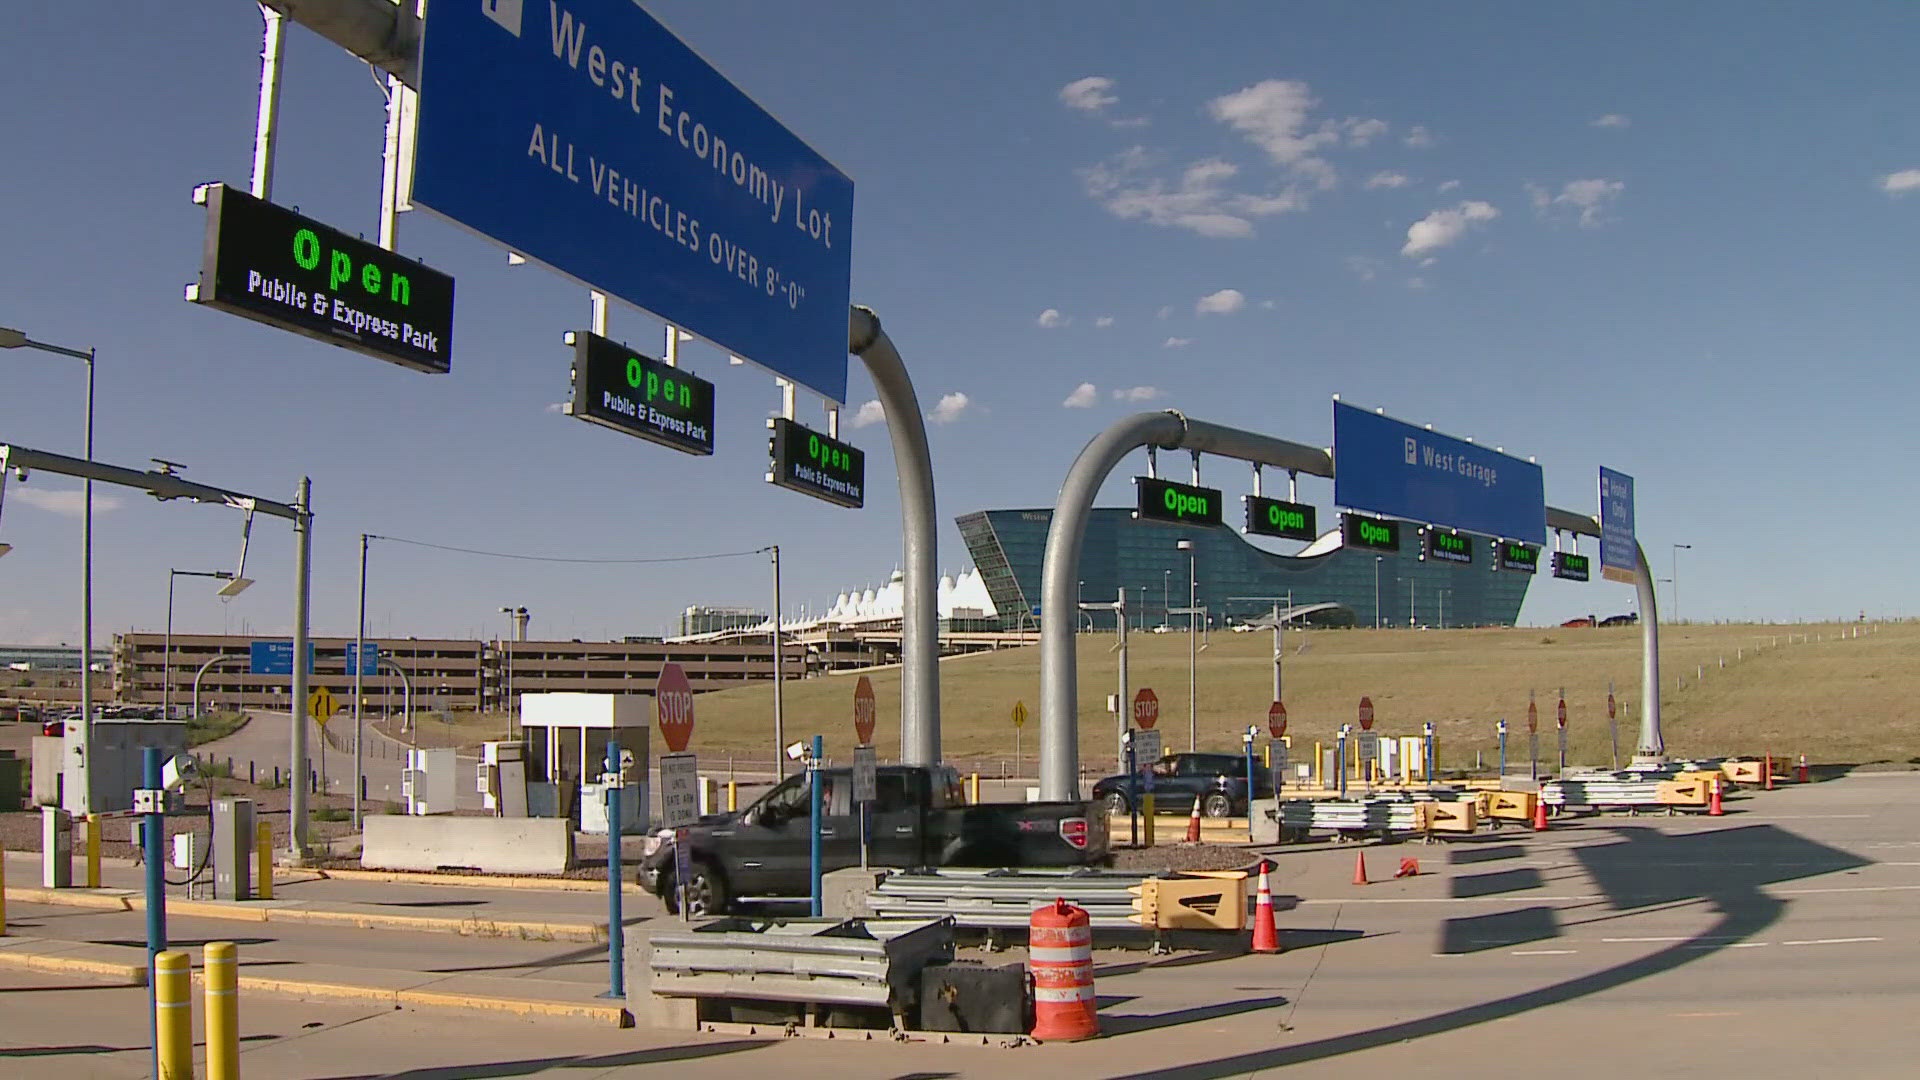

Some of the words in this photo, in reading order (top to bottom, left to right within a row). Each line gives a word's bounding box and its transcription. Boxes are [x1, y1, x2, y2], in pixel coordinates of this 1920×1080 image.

[550, 0, 641, 114] West
[658, 83, 784, 223] Economy
[796, 188, 832, 249] Lot
[528, 123, 579, 183] ALL
[590, 156, 699, 252] VEHICLES
[709, 232, 758, 288] OVER
[293, 228, 411, 306] Open
[248, 269, 307, 310] Public
[312, 292, 329, 316] &
[332, 298, 399, 340] Express
[403, 322, 438, 352] Park
[626, 358, 691, 409] Open
[603, 390, 635, 417] Public
[638, 402, 648, 419] &
[649, 407, 685, 434] Express
[686, 419, 707, 442] Park
[809, 434, 849, 472] Open
[1423, 444, 1453, 473] West
[1457, 455, 1497, 487] Garage
[795, 462, 815, 483] Public
[816, 471, 822, 485] &
[823, 473, 846, 492] Express
[846, 482, 860, 498] Park
[1164, 488, 1207, 517] Open
[1269, 505, 1304, 531] Open
[1360, 522, 1390, 544] Open
[1440, 534, 1464, 550] Open
[1509, 545, 1530, 560] Open
[660, 691, 691, 724] STOP
[855, 698, 874, 723] STOP
[1135, 701, 1157, 717] STOP
